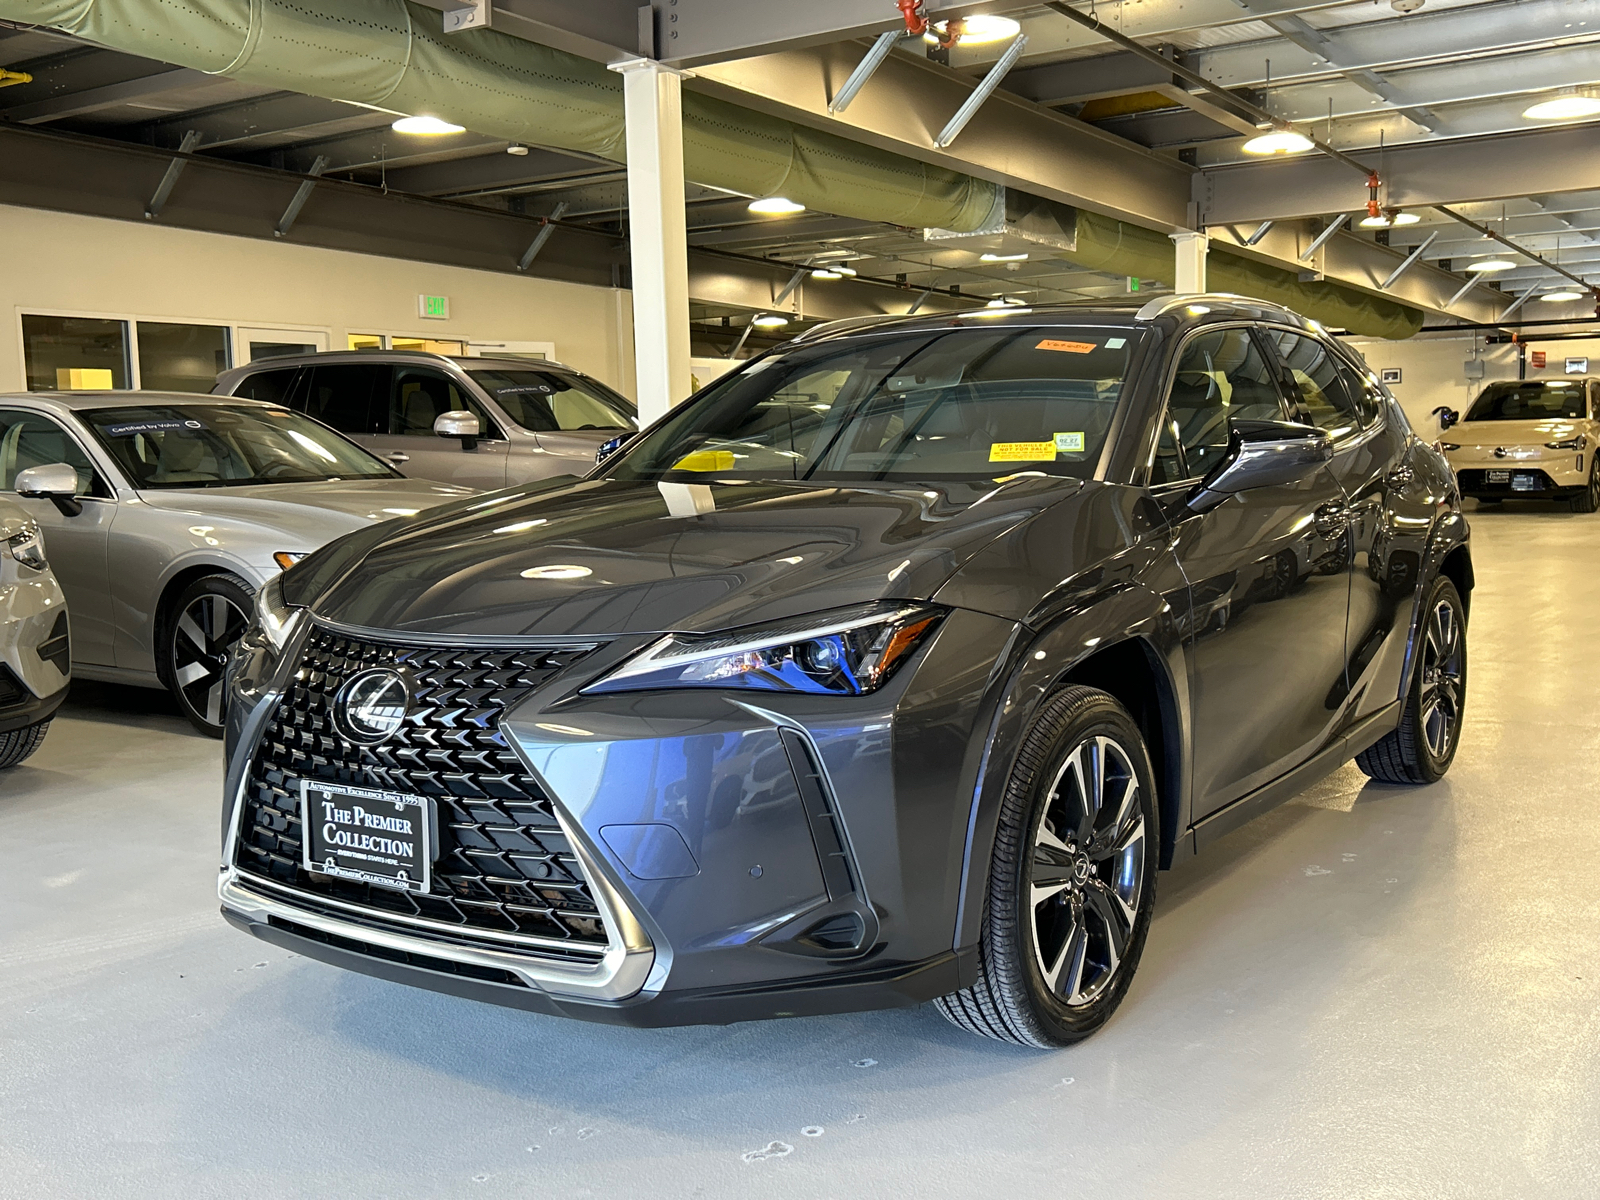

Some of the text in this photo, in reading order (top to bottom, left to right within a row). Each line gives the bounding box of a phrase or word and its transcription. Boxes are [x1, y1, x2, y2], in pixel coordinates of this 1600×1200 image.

[427, 297, 444, 315] EXIT
[112, 424, 147, 433] Certified
[309, 782, 347, 795] AUTOMOTIVE
[347, 787, 382, 799] EXCELLENCE
[383, 792, 402, 802] SINCE
[321, 801, 413, 835] THE PREMIER
[322, 822, 414, 858] COLLECTION
